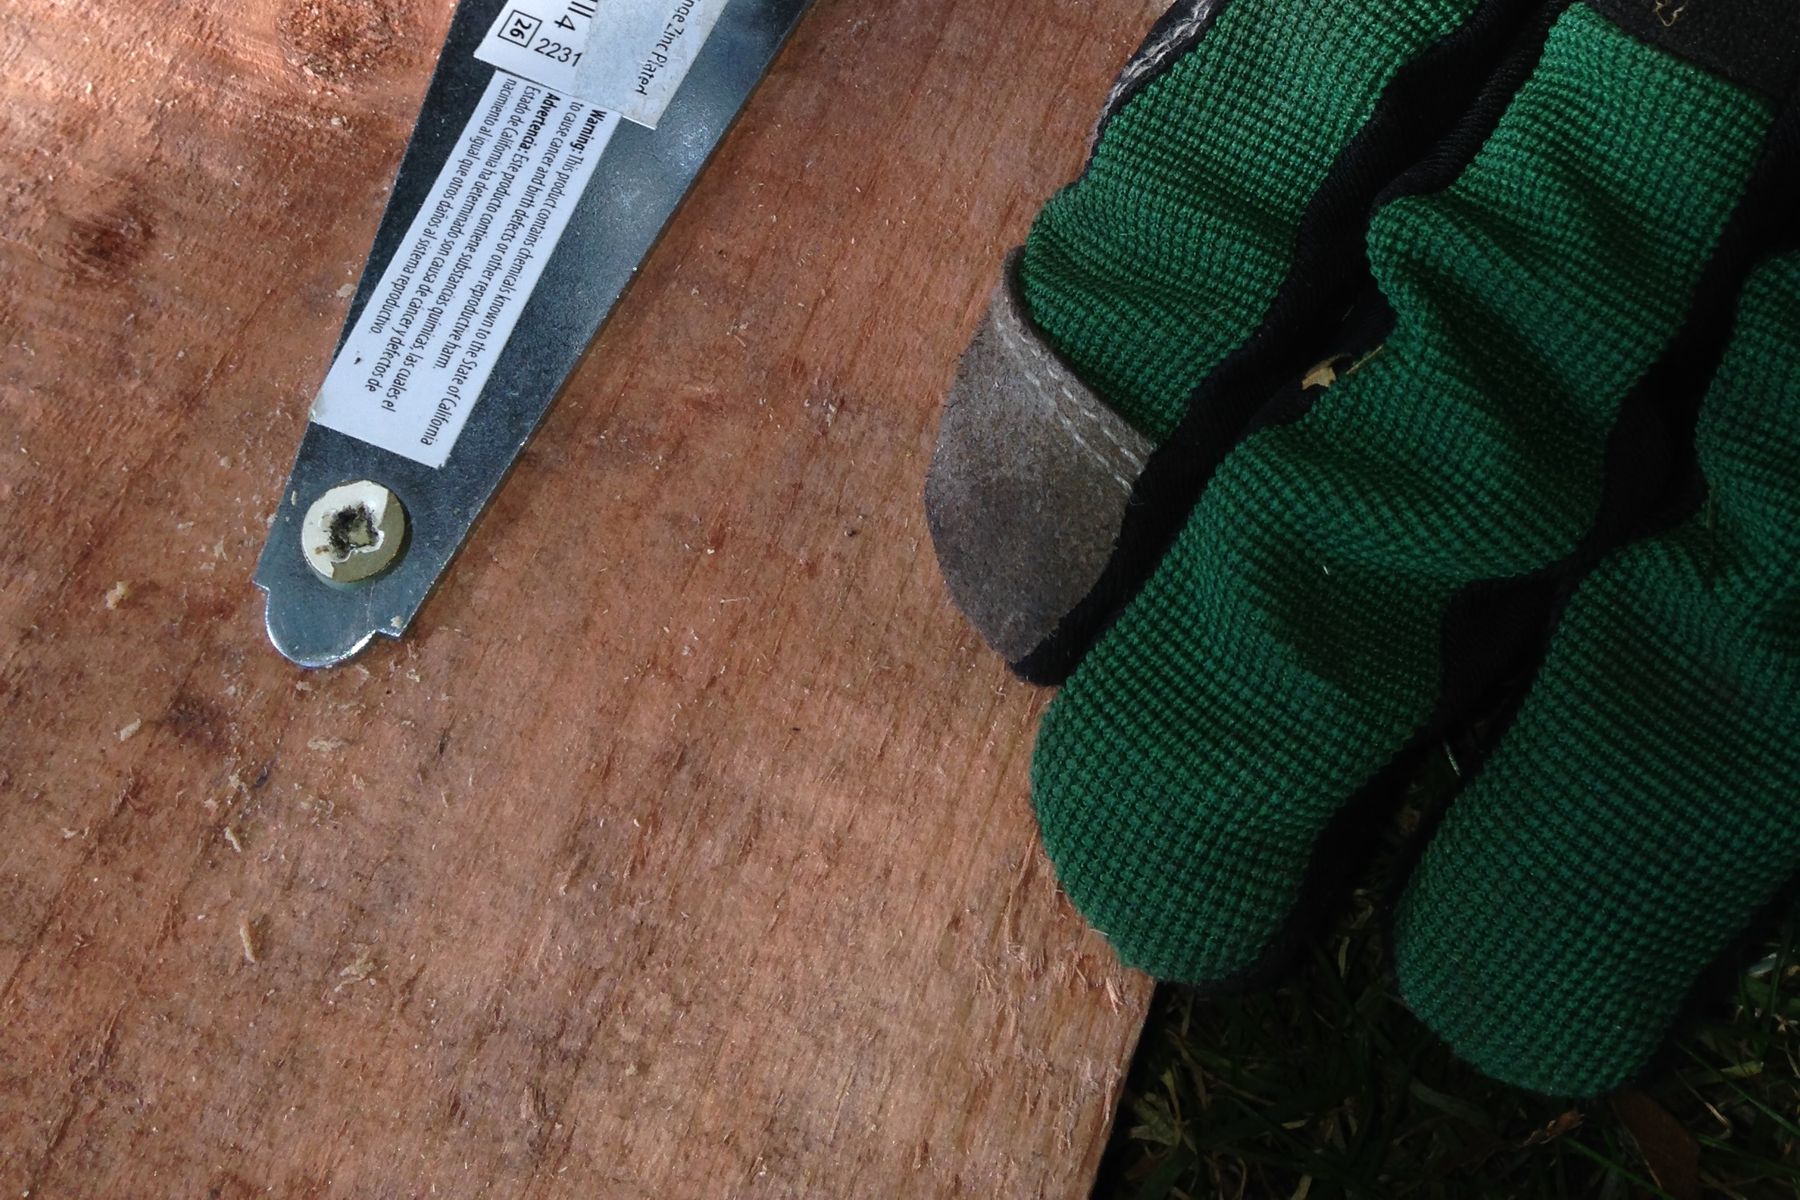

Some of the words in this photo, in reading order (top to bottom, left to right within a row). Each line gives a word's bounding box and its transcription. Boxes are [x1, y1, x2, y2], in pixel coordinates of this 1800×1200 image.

[510, 18, 532, 40] 26
[655, 22, 684, 52] Zinc
[534, 38, 583, 67] 2231
[483, 78, 517, 127] nacimiento
[514, 85, 542, 115] Estado
[569, 101, 585, 112] to
[478, 125, 493, 138] al
[507, 114, 525, 127] de
[517, 92, 561, 154] Advertencia:
[555, 111, 577, 137] cause
[569, 109, 607, 154] Warning:
[465, 135, 486, 161] igual
[485, 127, 519, 168] California
[541, 137, 564, 168] cancer
[456, 158, 474, 177] que
[478, 167, 497, 181] ha
[507, 153, 530, 173] Este
[530, 166, 549, 187] and
[561, 154, 585, 173] This
[443, 176, 464, 200] otros
[485, 171, 516, 213] producto
[519, 184, 543, 209] birth
[543, 171, 570, 209] product
[427, 200, 454, 228] daños
[447, 181, 489, 239] determinado
[422, 228, 438, 240] al
[464, 213, 494, 253] contiene
[500, 208, 529, 243] defects
[523, 208, 552, 248] contains
[402, 238, 430, 274] sistema
[437, 238, 455, 257] son
[495, 242, 509, 255] or
[422, 256, 445, 284] causa
[435, 252, 473, 307] substancias
[481, 254, 503, 282] other
[498, 247, 534, 294] chemicals
[370, 274, 411, 334] reproductivo.
[415, 283, 434, 297] de
[399, 297, 423, 330] cáncer
[448, 280, 489, 341] reproductive
[481, 294, 511, 328] known
[391, 326, 407, 337] y
[409, 306, 444, 350] químicas,
[475, 328, 491, 340] to
[371, 336, 405, 378] defectos
[403, 352, 424, 368] las
[435, 340, 462, 369] harm.
[465, 340, 486, 358] the
[365, 378, 383, 392] de
[386, 368, 411, 400] cuales
[451, 358, 478, 385] State
[381, 399, 396, 413] el
[446, 385, 461, 400] of
[420, 397, 457, 446] California
